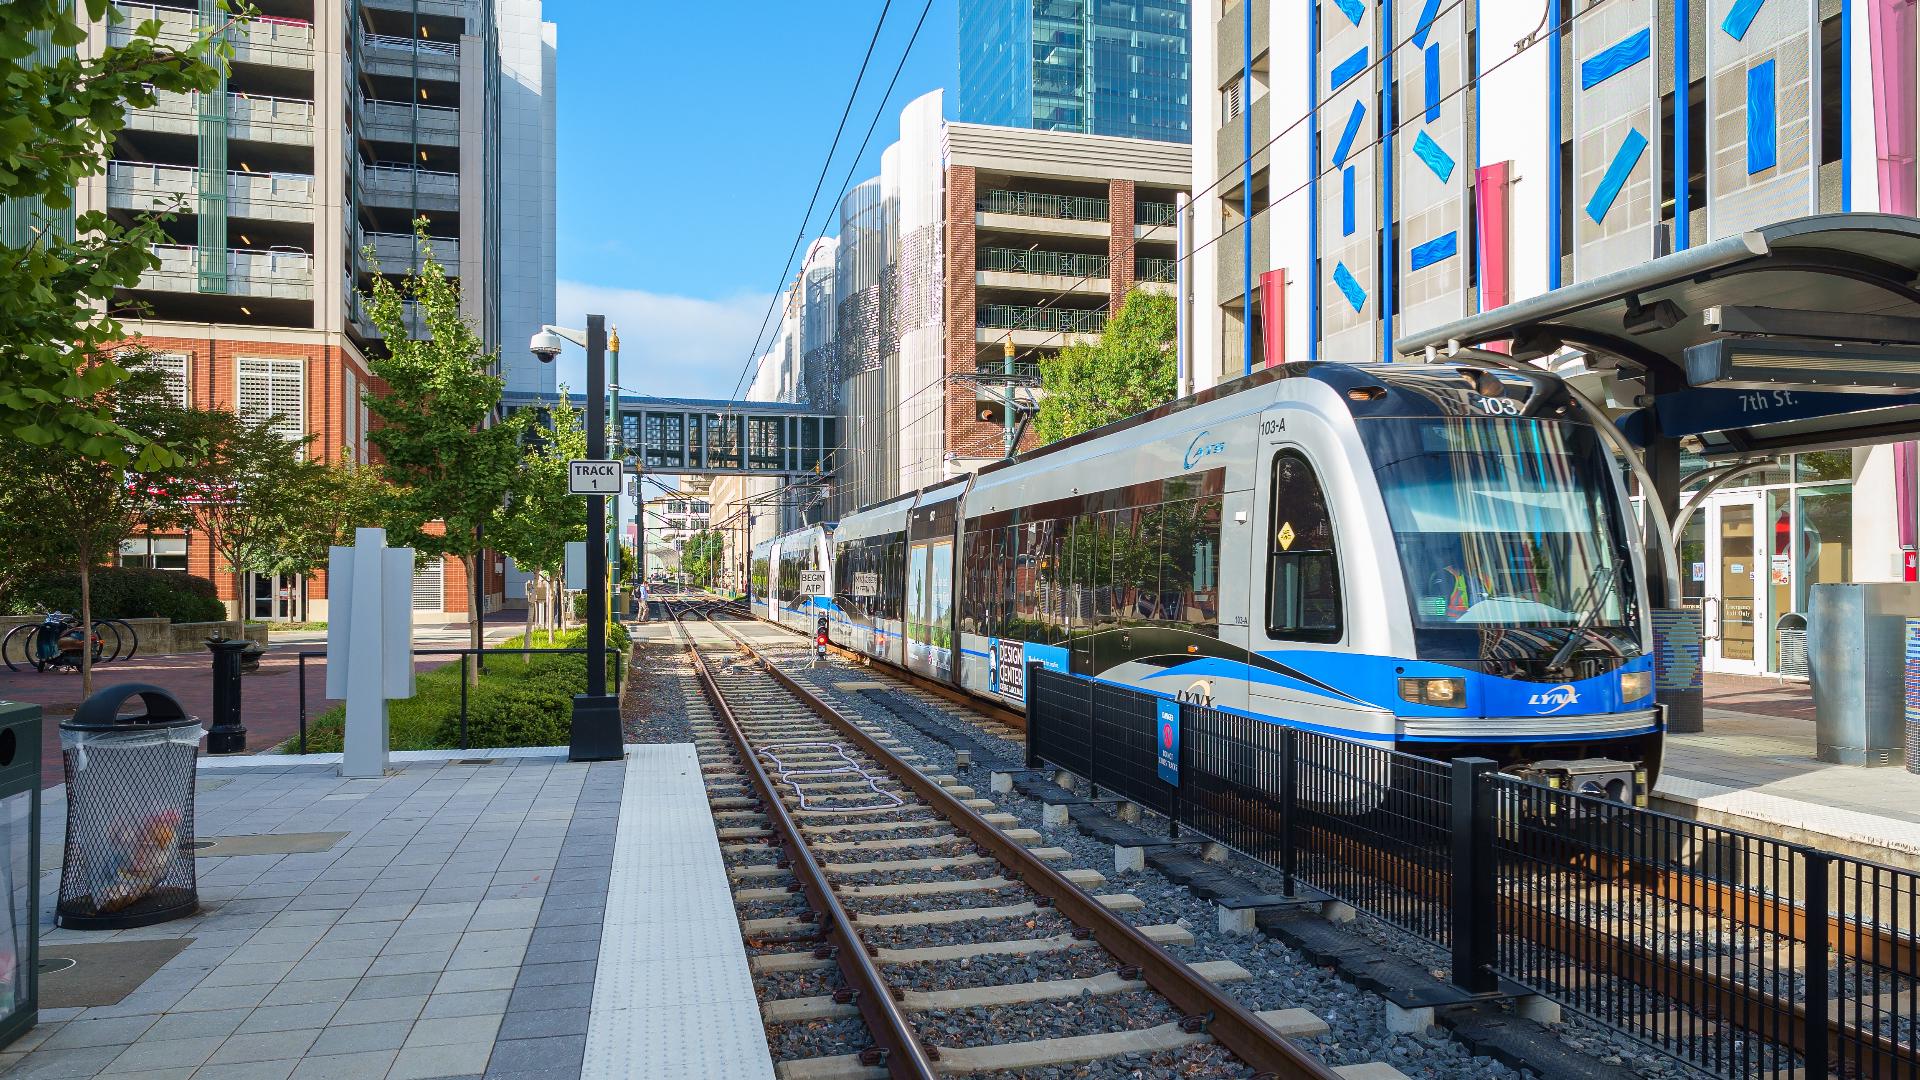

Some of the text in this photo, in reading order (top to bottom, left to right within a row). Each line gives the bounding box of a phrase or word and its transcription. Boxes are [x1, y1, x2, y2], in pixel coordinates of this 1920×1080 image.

[1477, 397, 1517, 415] 103
[1738, 389, 1798, 412] 7th St.
[1260, 417, 1286, 435] 103-A
[574, 465, 614, 476] TRACK
[591, 479, 597, 489] 1
[801, 573, 825, 582] BEGIN
[805, 584, 821, 593] ATP
[999, 644, 1023, 666] DESIGN
[999, 664, 1023, 686] CENTER
